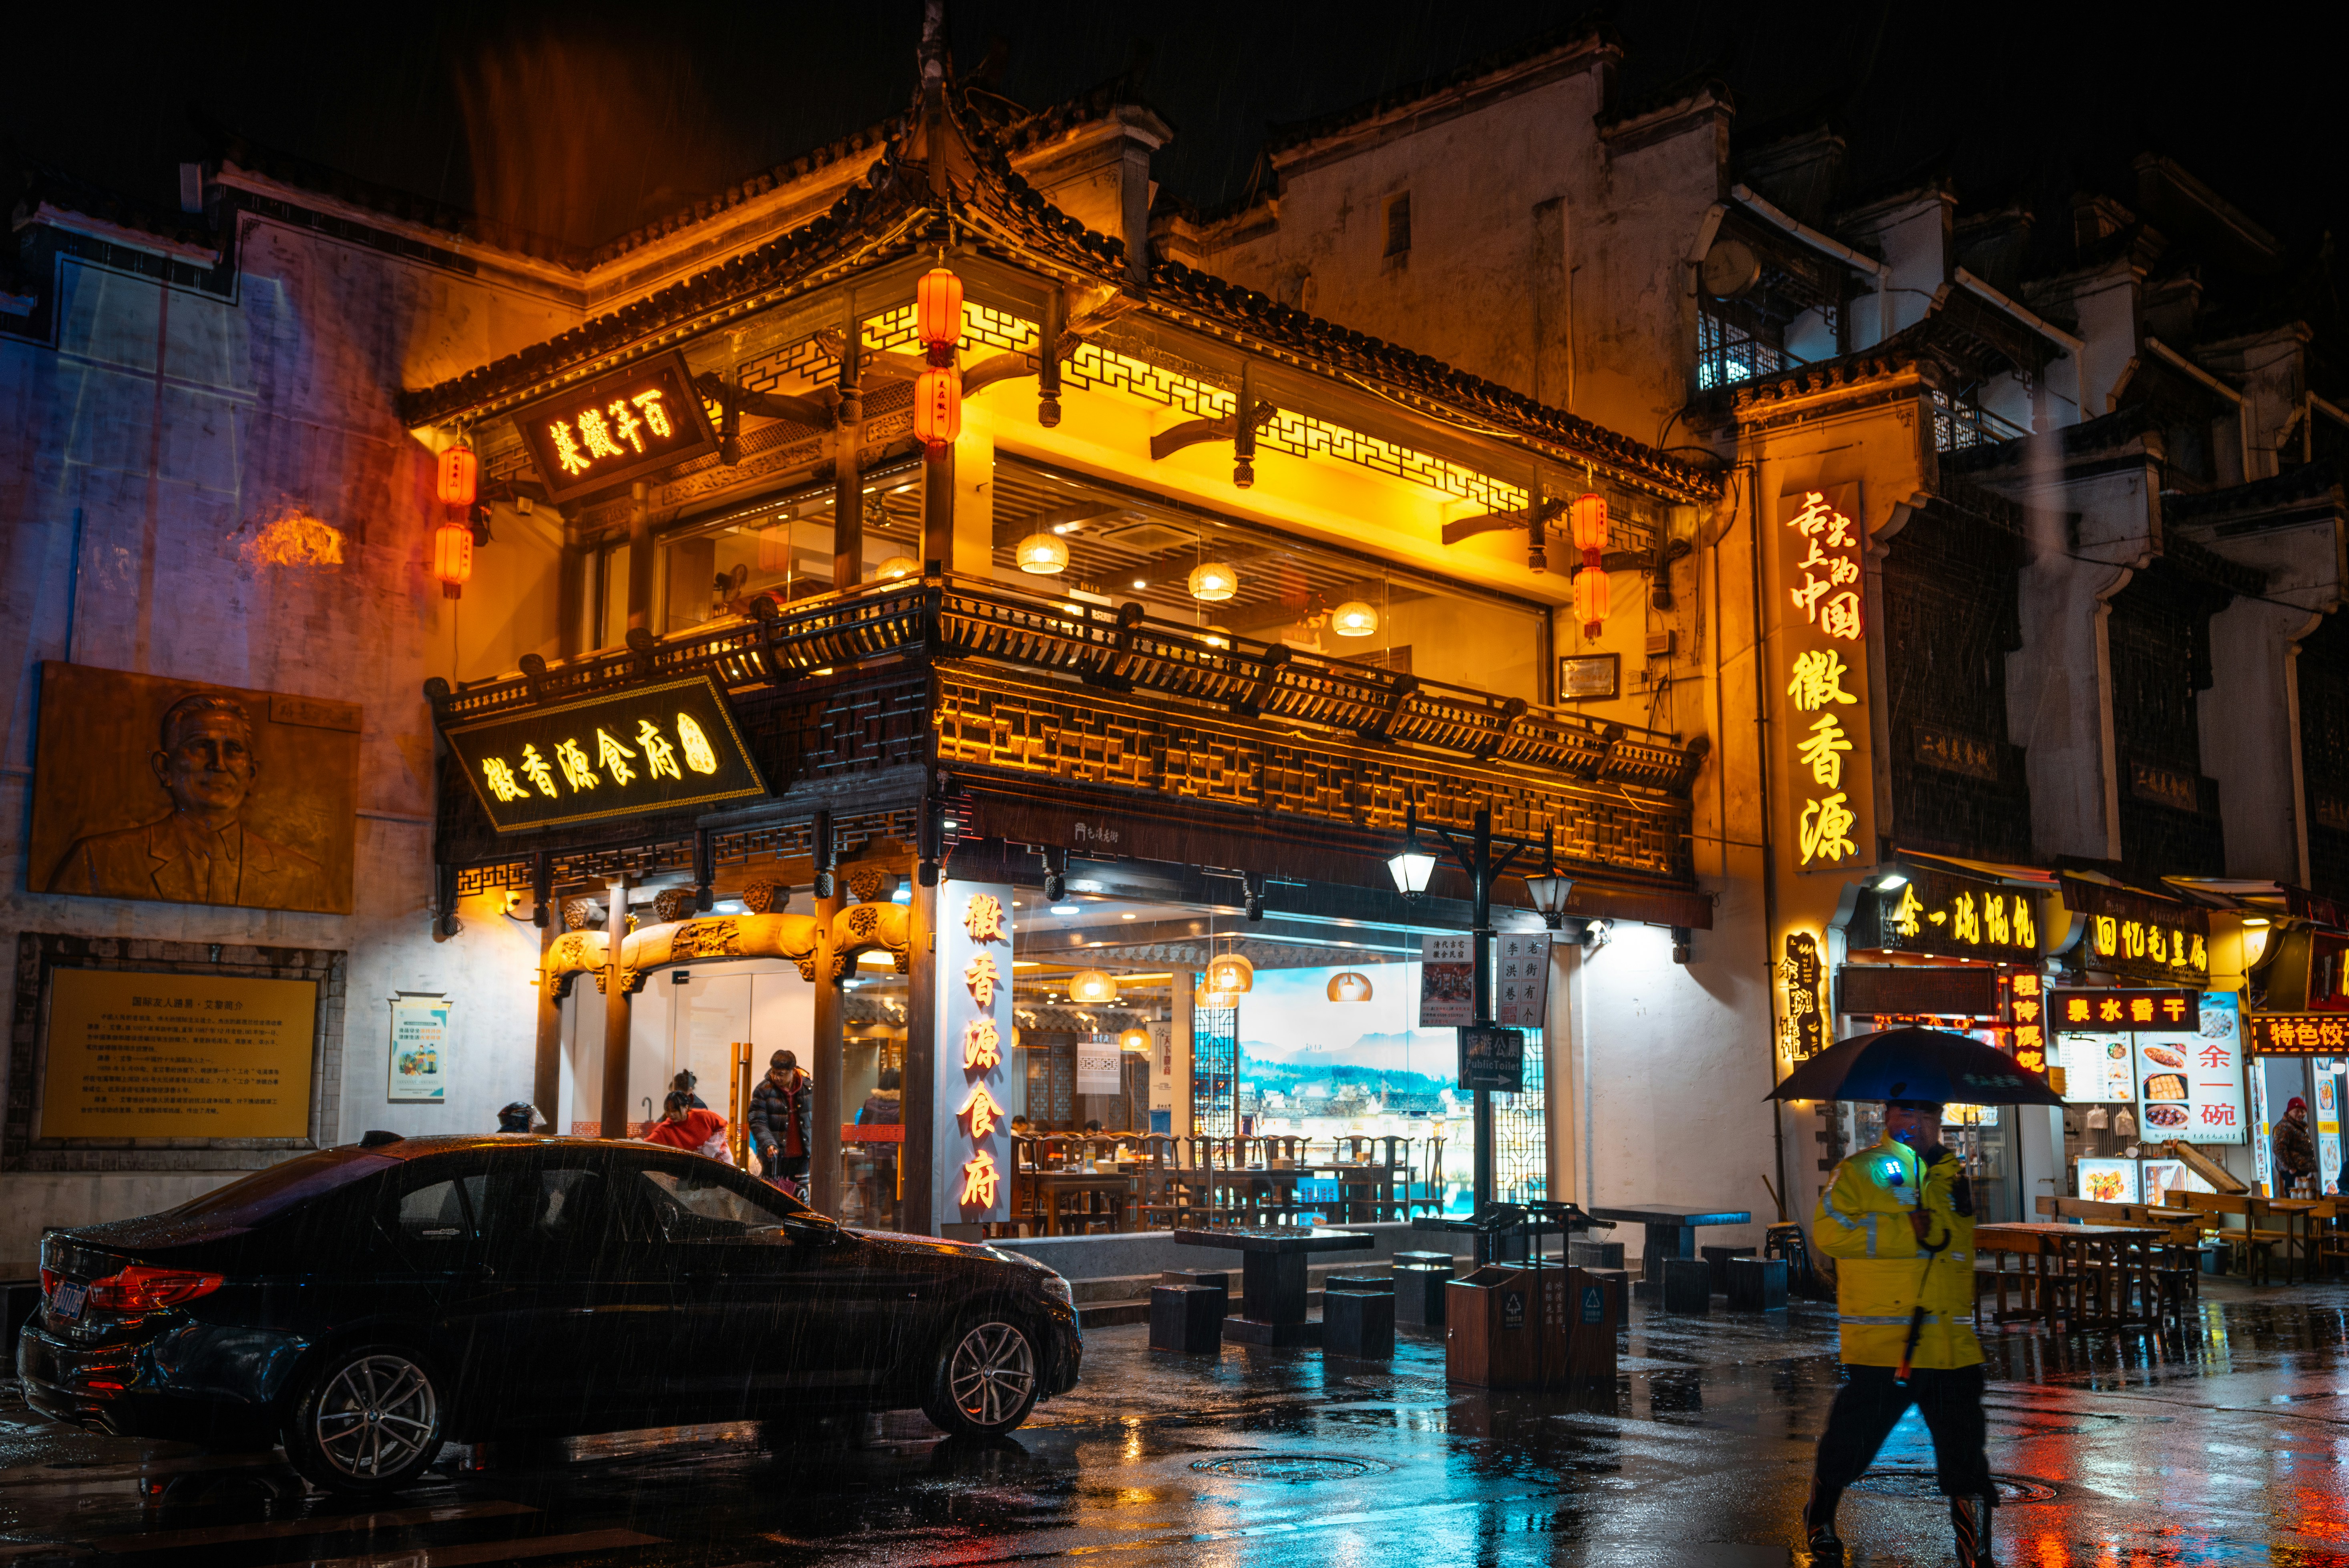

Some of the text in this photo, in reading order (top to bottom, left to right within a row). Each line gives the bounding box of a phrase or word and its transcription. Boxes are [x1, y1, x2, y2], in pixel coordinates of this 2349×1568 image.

[937, 380, 946, 423] 美在徽州
[482, 720, 682, 802] 徽香源食府
[1788, 649, 1858, 866] 徽香源
[1505, 942, 1518, 1000] 李洪巷
[2095, 915, 2207, 971] 回忆毛豆腐
[1523, 941, 1538, 1021] 老街有个
[2067, 998, 2186, 1022] 泉水香干
[959, 893, 1008, 1209] 徽香源食府
[1466, 1033, 1520, 1058] 旅游公厕
[2012, 975, 2045, 1073] 祖传馄饨
[2270, 1022, 2349, 1046] 特色饺
[2198, 1045, 2237, 1126] 余一碗
